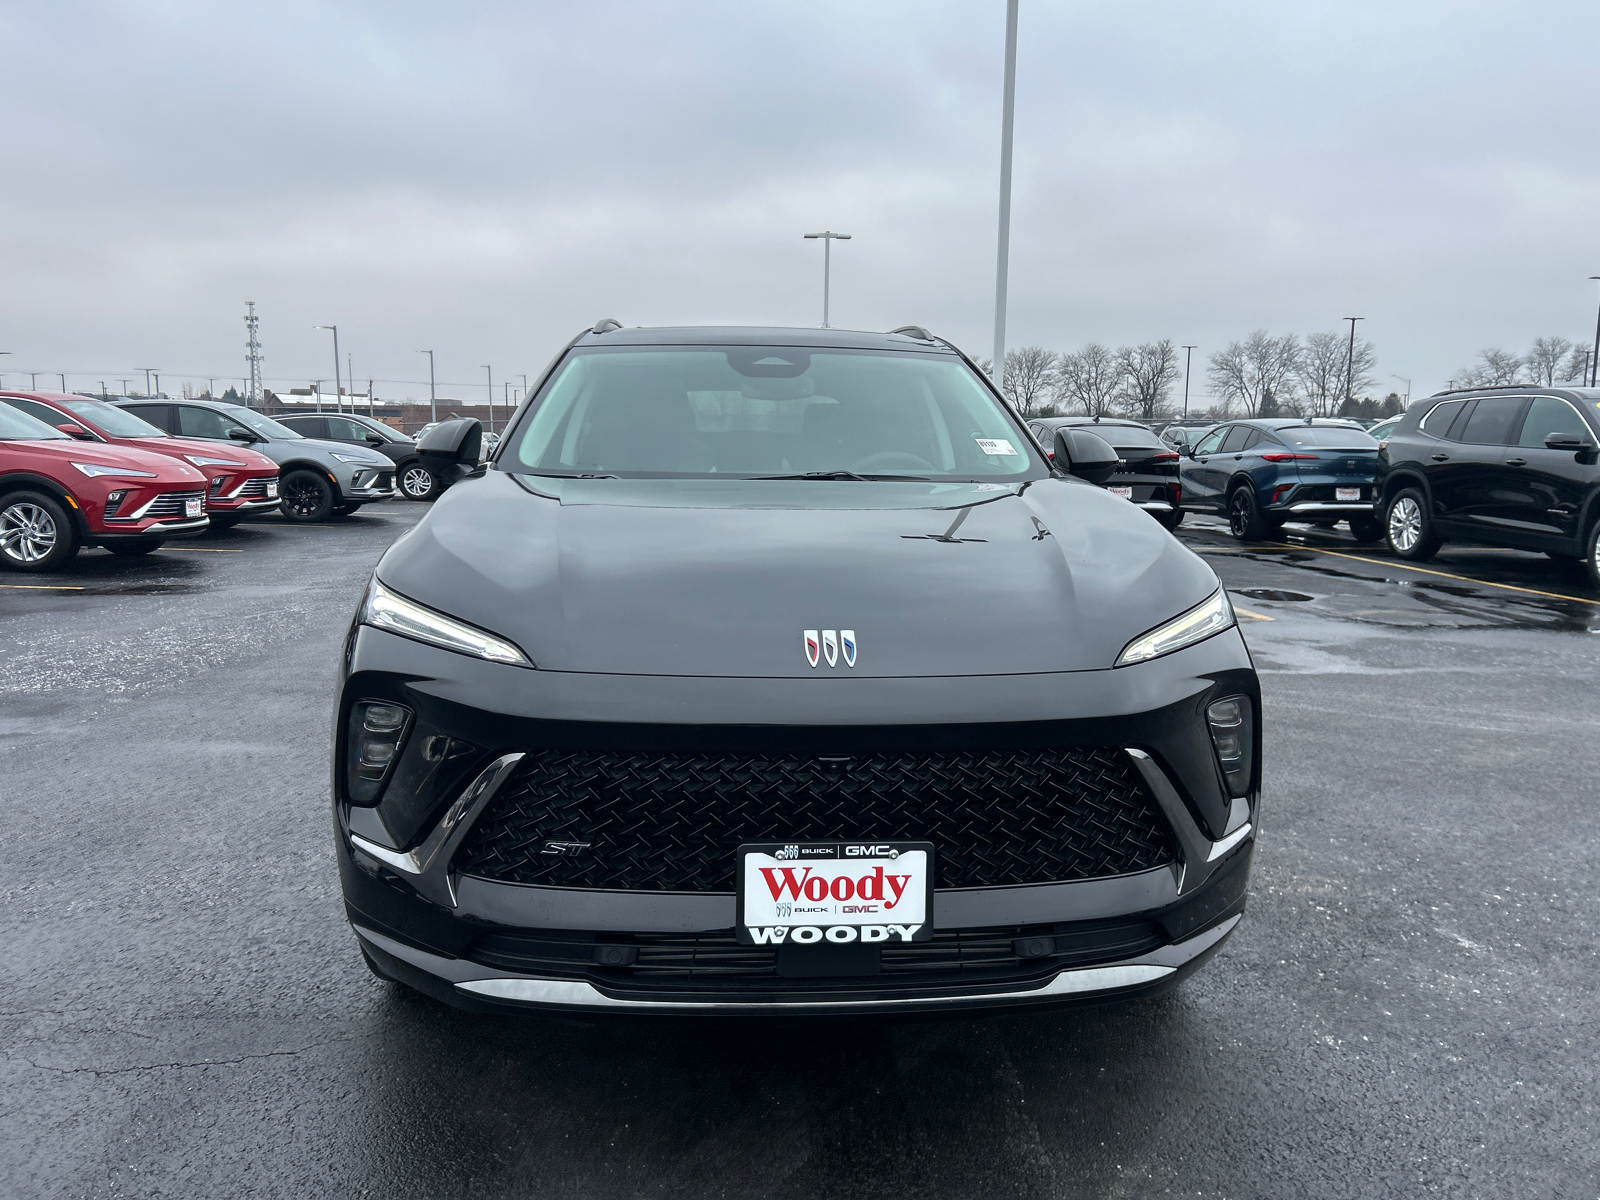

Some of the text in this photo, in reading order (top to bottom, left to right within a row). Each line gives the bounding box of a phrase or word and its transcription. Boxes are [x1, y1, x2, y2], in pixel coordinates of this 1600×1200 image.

[540, 842, 591, 856] ST
[845, 845, 890, 856] GMC
[758, 866, 912, 909] Woody
[842, 905, 878, 913] GMC
[748, 925, 922, 944] WOODY
